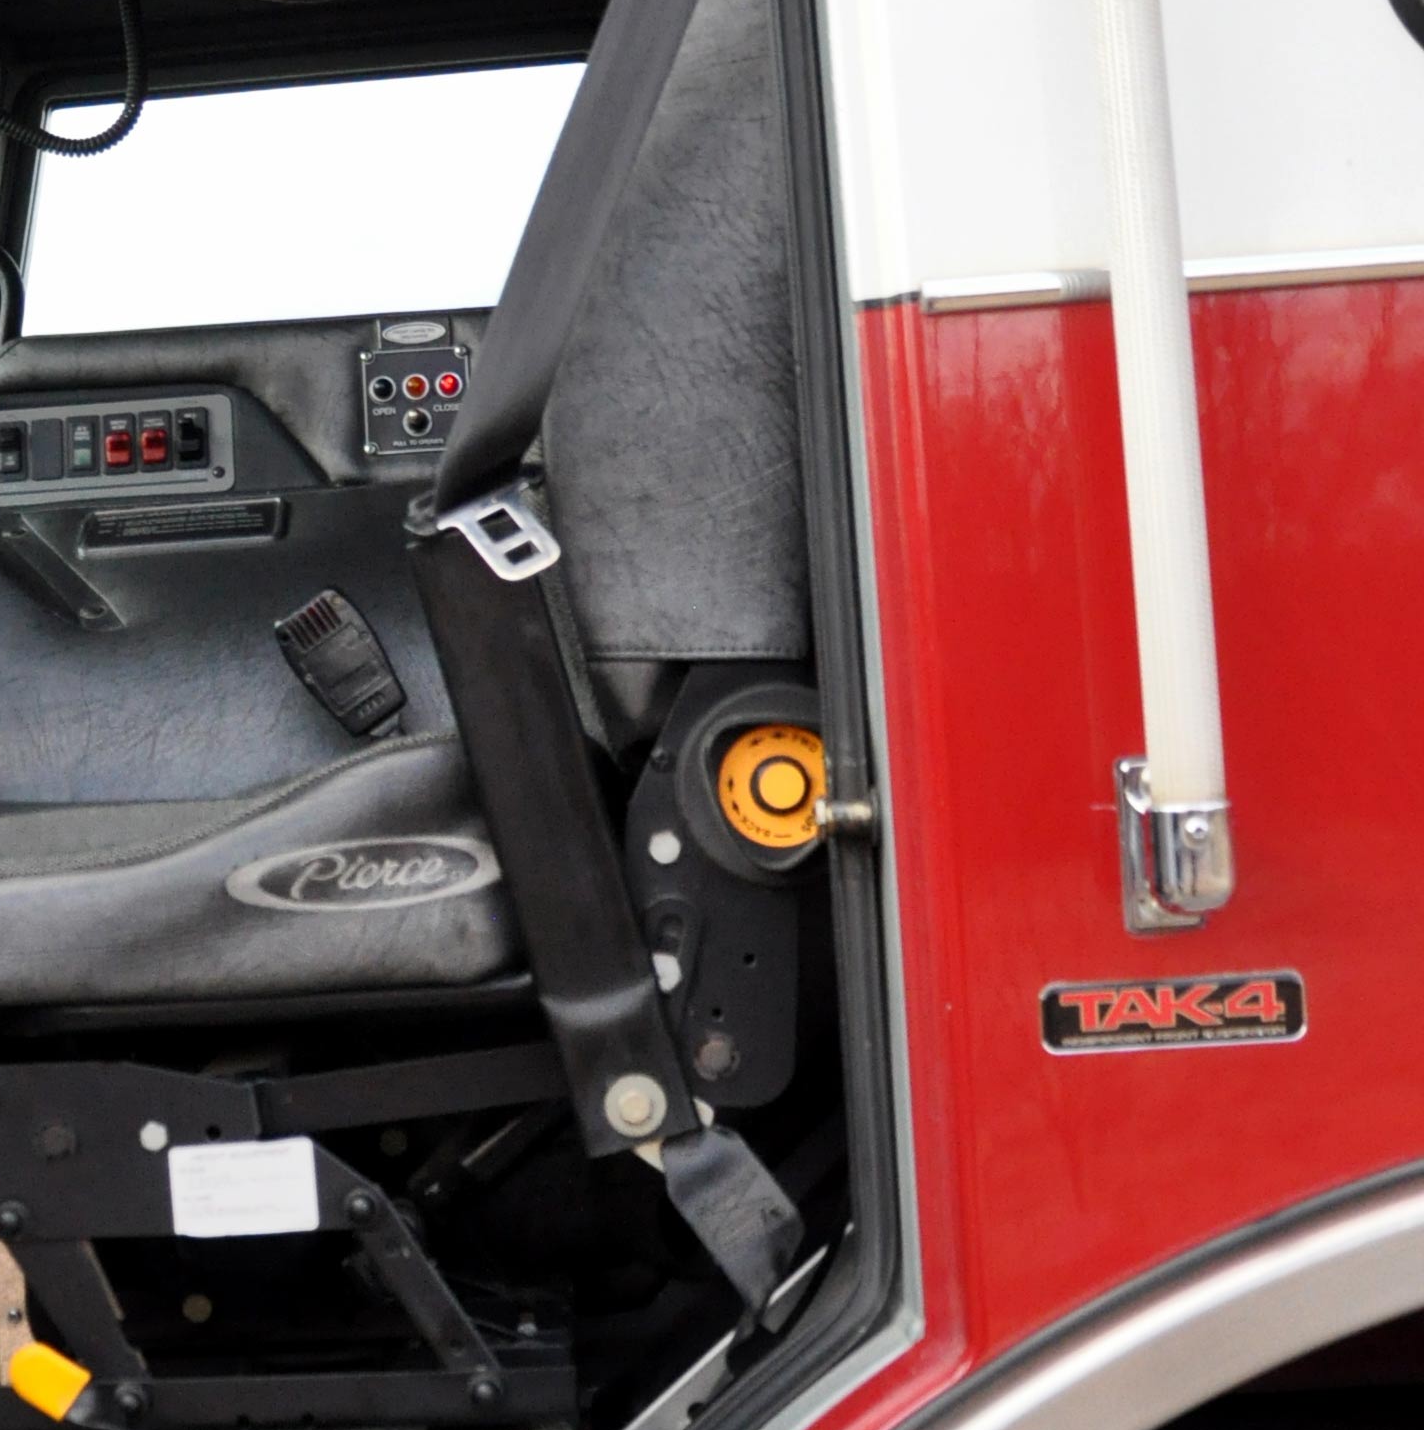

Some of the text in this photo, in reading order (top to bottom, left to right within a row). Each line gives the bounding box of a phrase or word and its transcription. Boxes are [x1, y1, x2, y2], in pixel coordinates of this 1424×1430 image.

[372, 407, 396, 416] OPEN
[289, 852, 447, 901] Pierce
[1059, 979, 1286, 1033] TAK-4
